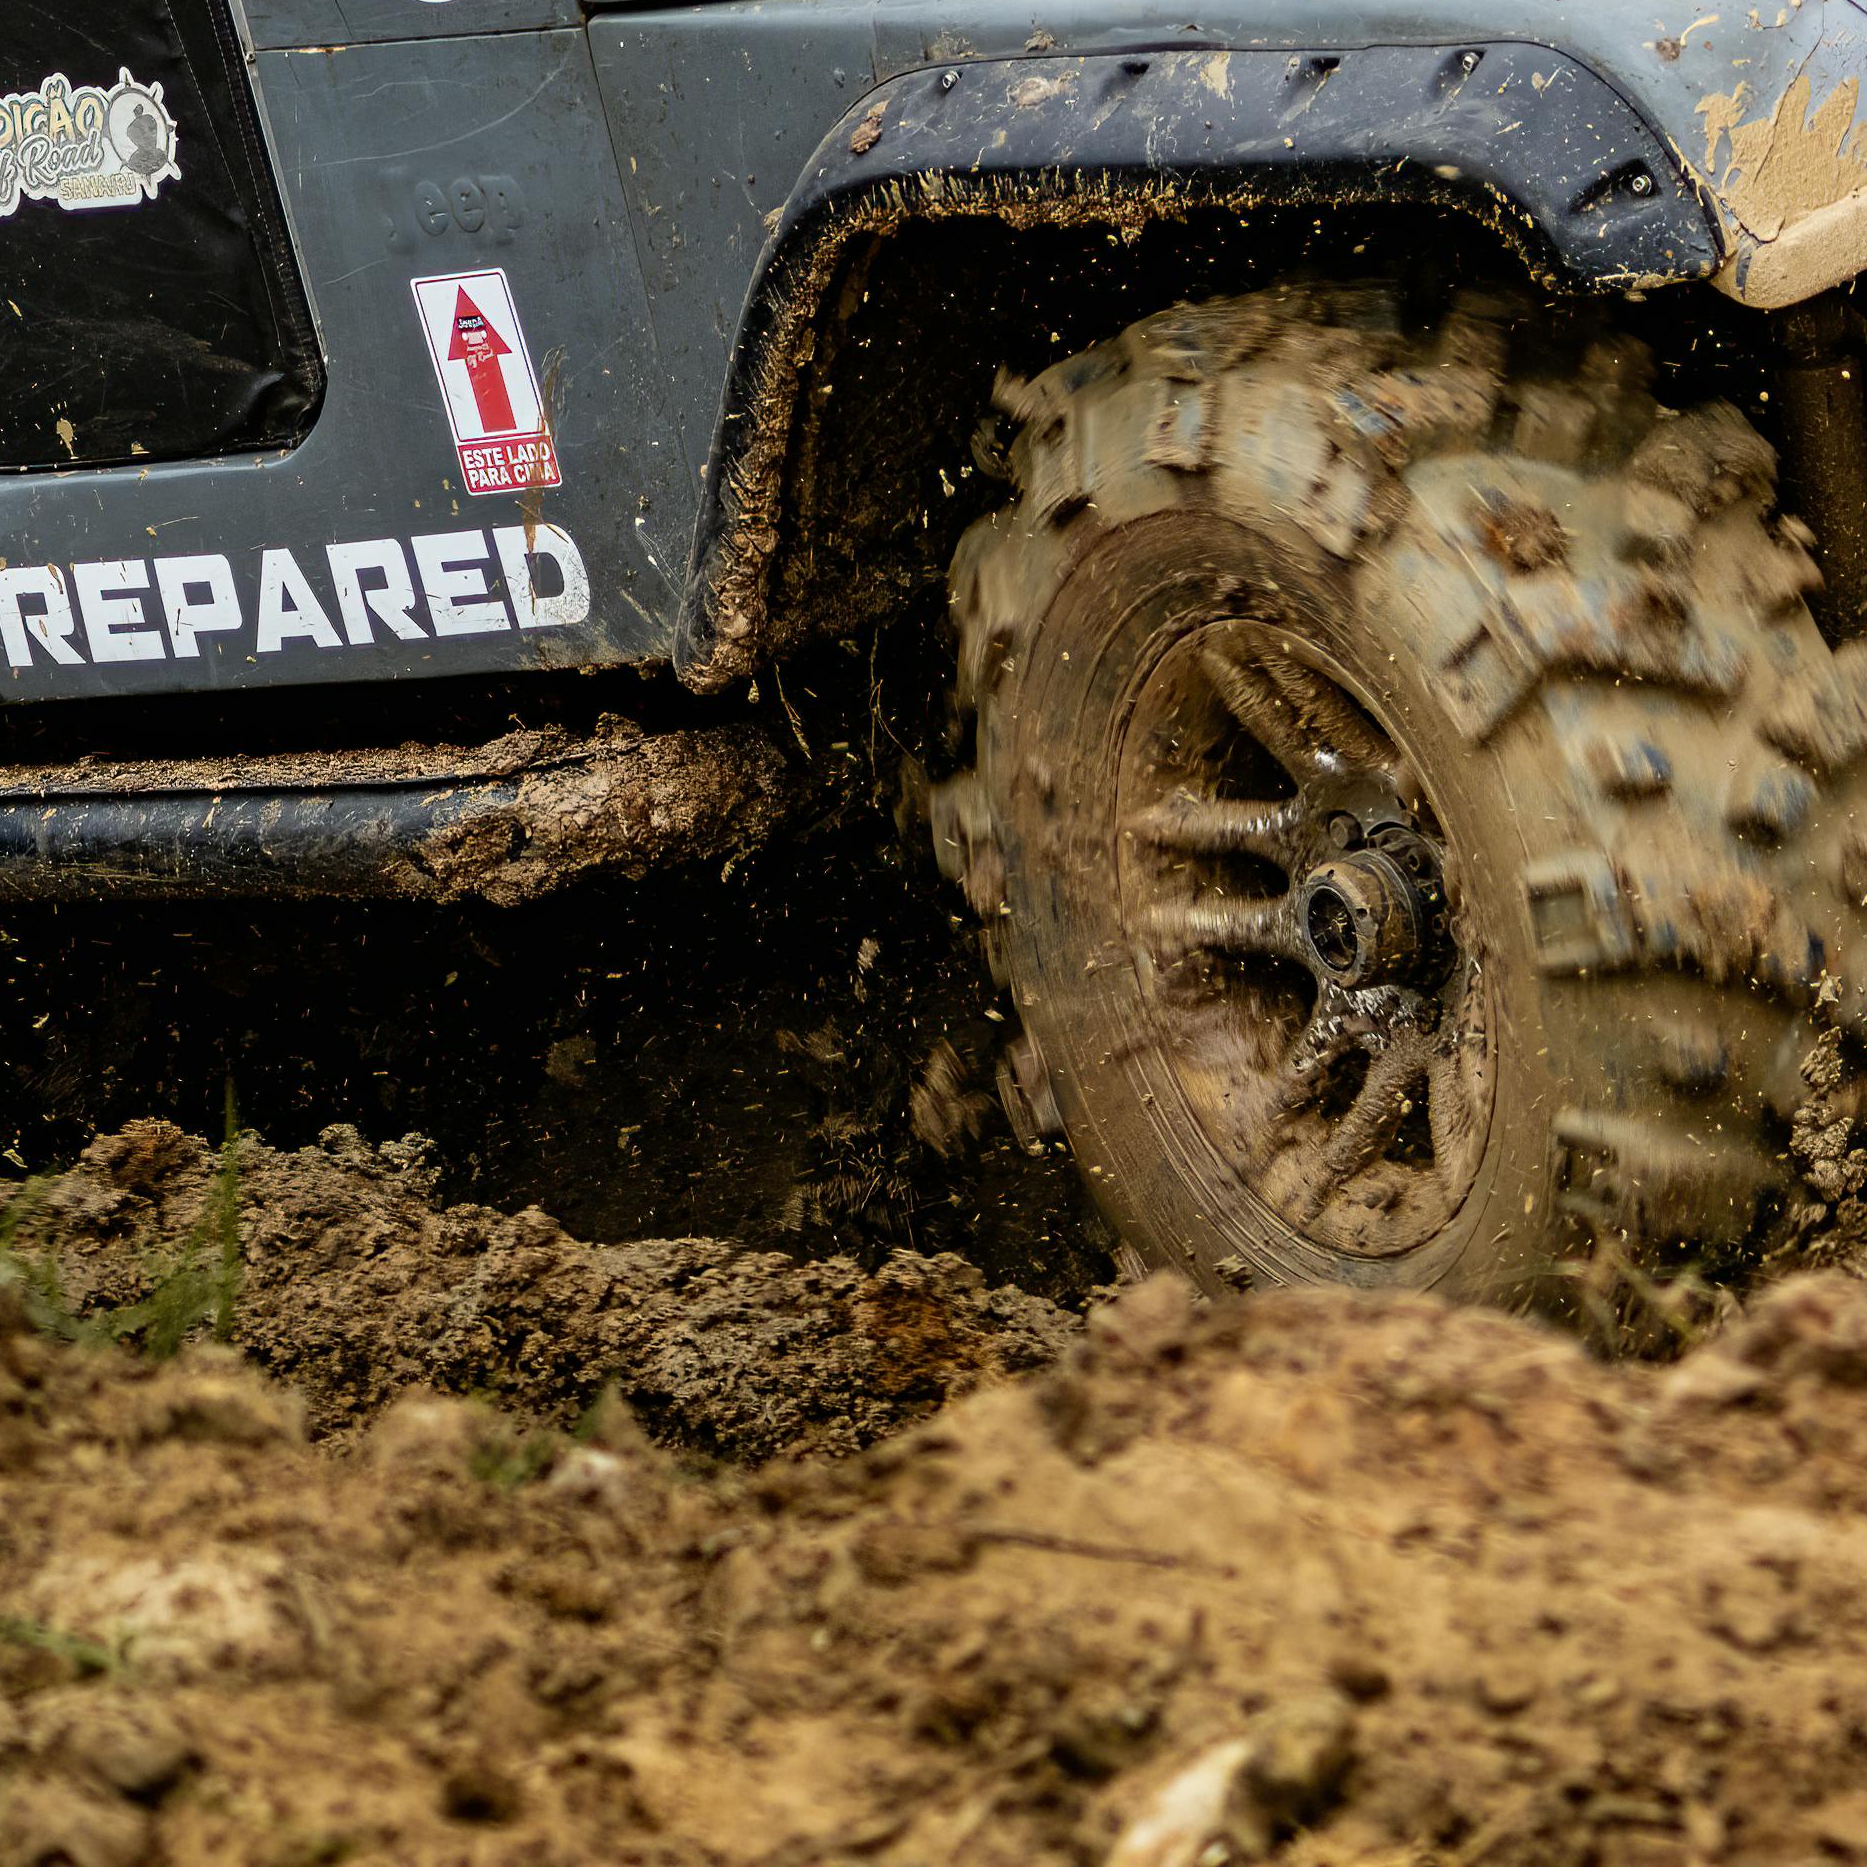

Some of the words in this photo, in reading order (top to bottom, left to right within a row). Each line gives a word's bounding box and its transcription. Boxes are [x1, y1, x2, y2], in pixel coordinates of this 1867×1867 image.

[17, 129, 104, 187] Road
[462, 447, 505, 469] ESTE
[506, 441, 551, 465] LADO
[467, 466, 513, 488] PARA
[514, 461, 557, 484] CIA
